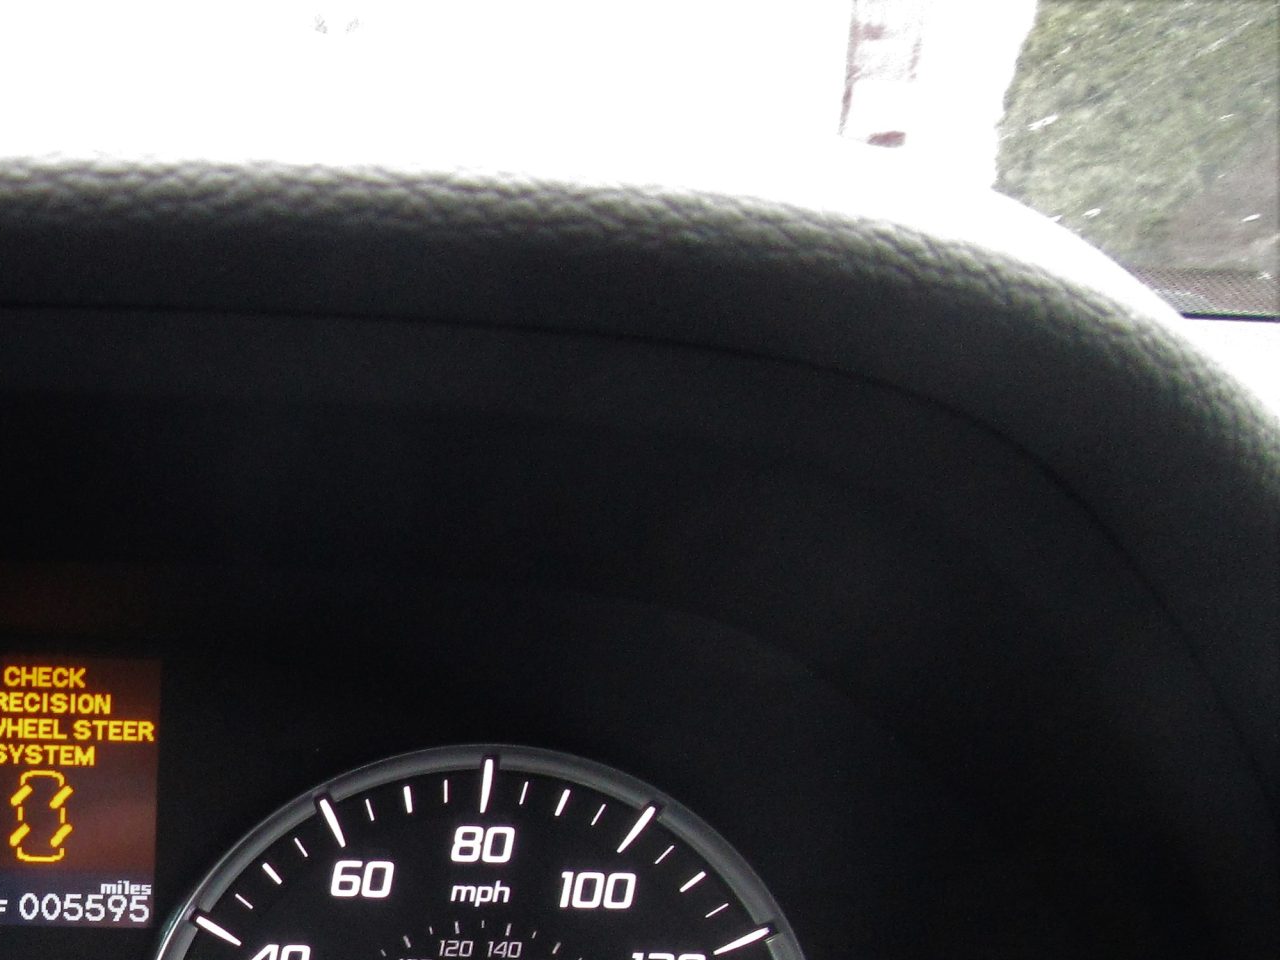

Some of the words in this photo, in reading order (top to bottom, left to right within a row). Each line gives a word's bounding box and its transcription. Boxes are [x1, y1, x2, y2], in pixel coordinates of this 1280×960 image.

[3, 666, 86, 689] CHECK
[73, 719, 154, 742] STEER
[450, 825, 516, 864] 80
[100, 880, 152, 895] miles
[330, 860, 395, 899] 60
[559, 871, 637, 910] 100
[450, 880, 511, 908] mph
[19, 892, 151, 922] 005595
[439, 940, 474, 957] 120
[487, 941, 523, 959] 140
